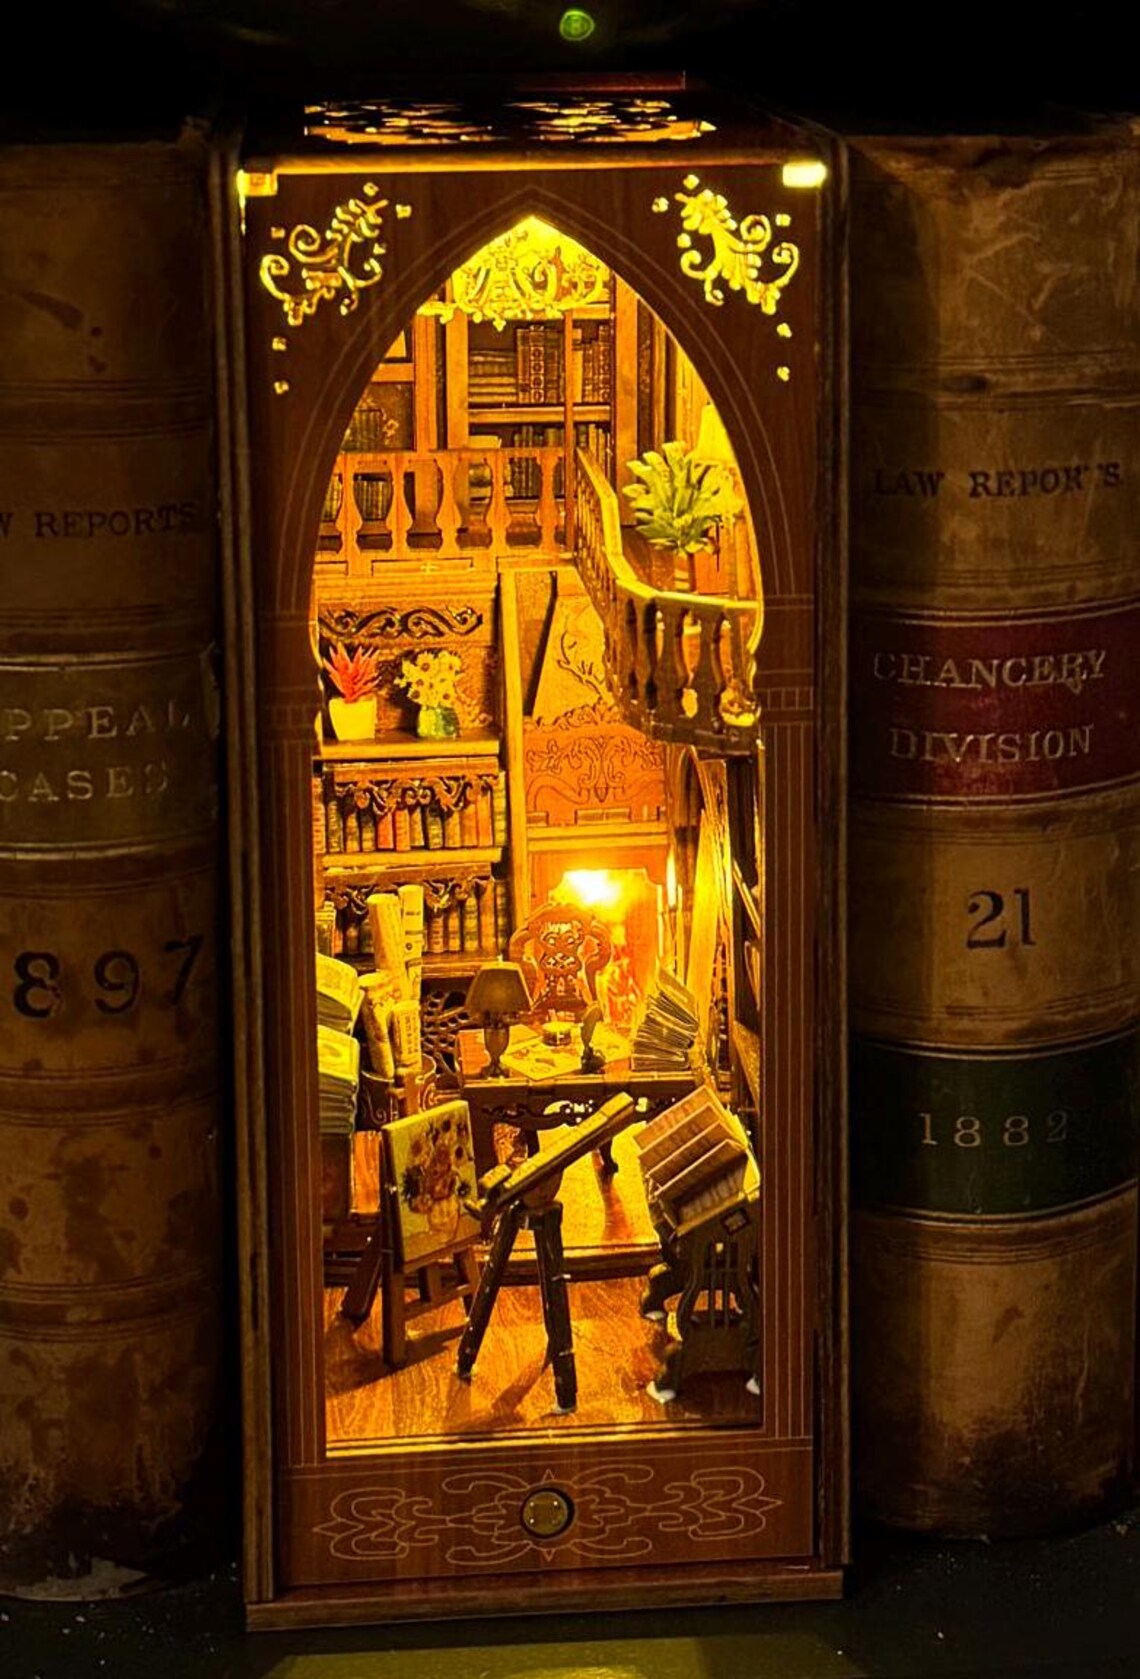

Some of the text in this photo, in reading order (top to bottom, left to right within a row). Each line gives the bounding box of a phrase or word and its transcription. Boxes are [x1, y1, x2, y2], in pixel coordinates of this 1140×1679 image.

[874, 462, 1121, 497] LAW REPORS
[35, 502, 199, 538] REPORTS
[873, 650, 1107, 694] CHANCERY
[889, 724, 1094, 764] DIVISION
[965, 888, 1036, 950] 21
[13, 936, 204, 1019] 897
[918, 1110, 1070, 1148] 1882
